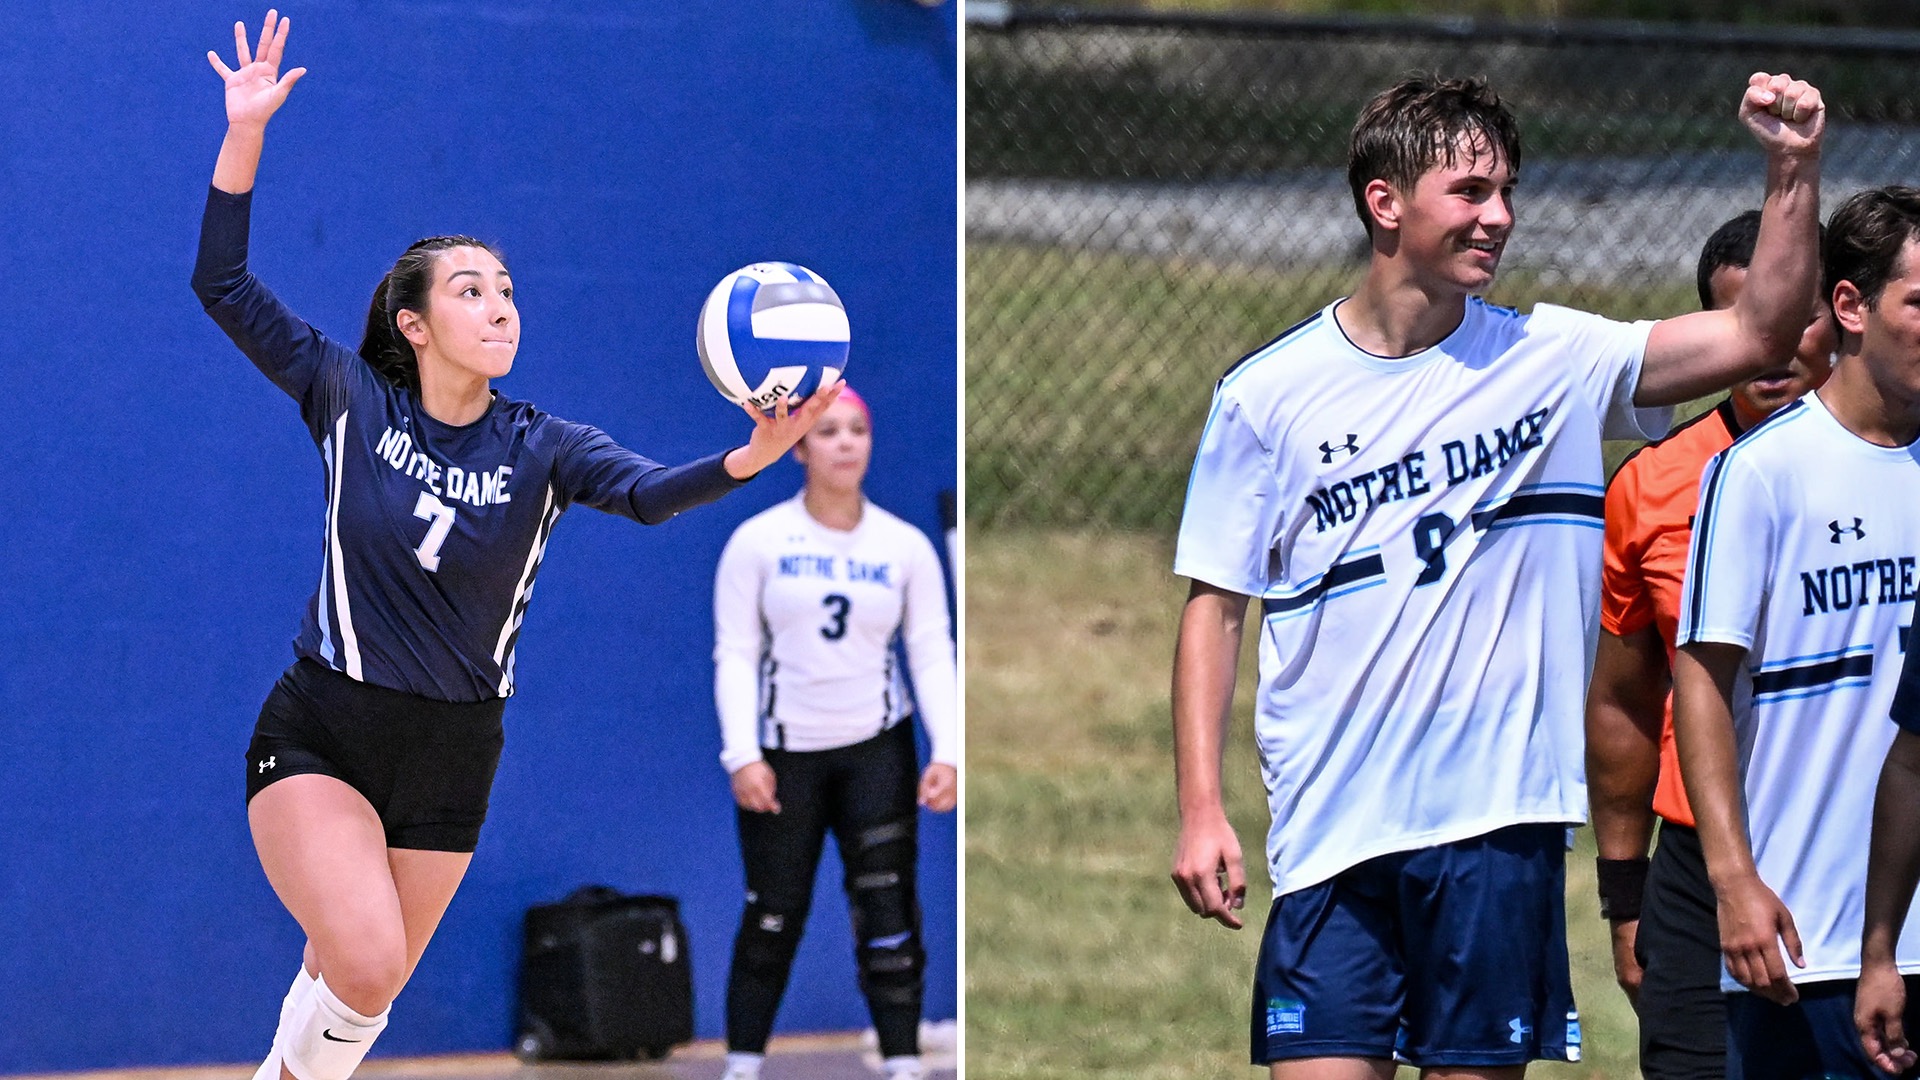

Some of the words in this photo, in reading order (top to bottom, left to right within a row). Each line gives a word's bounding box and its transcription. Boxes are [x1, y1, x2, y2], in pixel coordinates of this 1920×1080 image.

[446, 464, 514, 507] DAME
[1304, 451, 1431, 534] NOTRE
[1441, 407, 1549, 487] DAME
[412, 490, 457, 573] 7
[821, 593, 851, 641] 3
[1800, 556, 1917, 618] NOTRE
